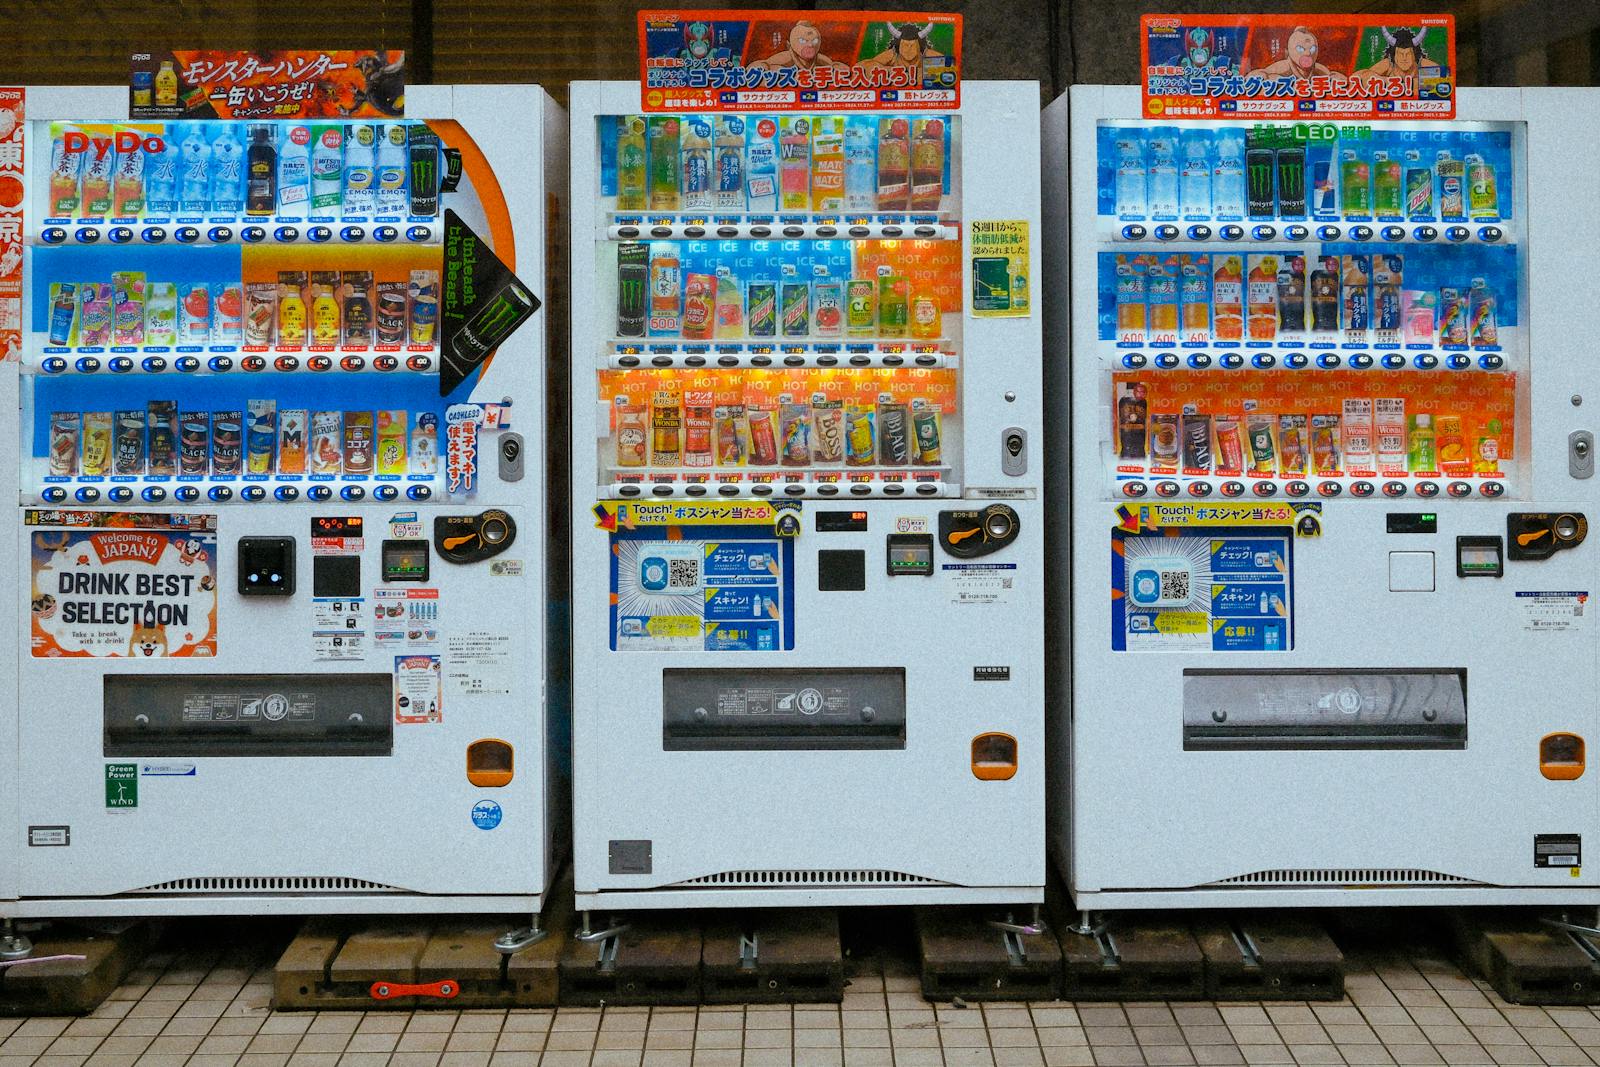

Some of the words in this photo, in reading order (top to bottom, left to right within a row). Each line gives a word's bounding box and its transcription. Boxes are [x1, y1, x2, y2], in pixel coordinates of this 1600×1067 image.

[183, 55, 348, 86] モンスターハンター
[647, 71, 687, 80] オリジナル
[690, 66, 918, 90] コラボグッズを手に入れろ!
[1148, 79, 1186, 87] オリジナル
[1190, 75, 1414, 98] コラボグッズを手に入れろ!
[743, 93, 789, 101] サウナグッズ
[821, 92, 871, 101] キャンプグッズ
[904, 91, 949, 100] 筋トレグッズ
[1242, 102, 1287, 110] サウナグッズ
[1319, 102, 1368, 110] キャンプグッズ
[1400, 102, 1444, 110] 筋トレグッズ
[1295, 126, 1336, 140] LED
[64, 131, 165, 161] DyDo
[155, 160, 177, 179] 水
[188, 160, 209, 179] 水
[220, 160, 240, 179] 水
[448, 225, 462, 257] the
[812, 241, 831, 251] ICE
[689, 244, 708, 253] ICE
[719, 243, 738, 253] ICE
[750, 242, 769, 252] ICE
[781, 242, 800, 251] ICE
[972, 246, 1026, 256] 認められました
[828, 256, 847, 266] ICE
[898, 254, 922, 264] HOT
[462, 236, 478, 305] Unleash
[445, 262, 464, 320] Beast!
[818, 300, 839, 308] トマト
[658, 380, 683, 391] HOT
[694, 377, 720, 389] HOT
[747, 380, 772, 391] HOT
[783, 381, 808, 391] HOT
[819, 381, 844, 392] HOT
[854, 382, 880, 392] HOT
[890, 383, 916, 393] HOT
[622, 383, 648, 394] HOT
[926, 384, 952, 393] HOT
[1416, 400, 1440, 410] HOT
[448, 409, 480, 421] CASHLESS
[653, 418, 680, 428] WONDA
[283, 431, 302, 449] M
[346, 440, 369, 449] ココア
[447, 426, 462, 493] 使えます!
[461, 421, 477, 490] 電子マネー
[632, 504, 673, 516] Touch!
[674, 506, 771, 521] ボスジャン当たる!
[1153, 505, 1195, 517] Touch!
[1196, 508, 1291, 522] ボスジャン当たる!
[639, 515, 667, 523] だけでも
[1160, 516, 1188, 524] だけでも
[97, 534, 144, 546] Welcome
[146, 535, 158, 546] to
[101, 544, 157, 562] JAPAN!
[1219, 551, 1253, 561] チェック!
[713, 554, 748, 564] チェック!
[58, 572, 131, 596] DRINK
[136, 574, 195, 597] BEST
[714, 597, 749, 606] スキャン!
[1220, 593, 1256, 603] スキャン!
[62, 601, 189, 629] SELECTION
[108, 772, 135, 780] Power
